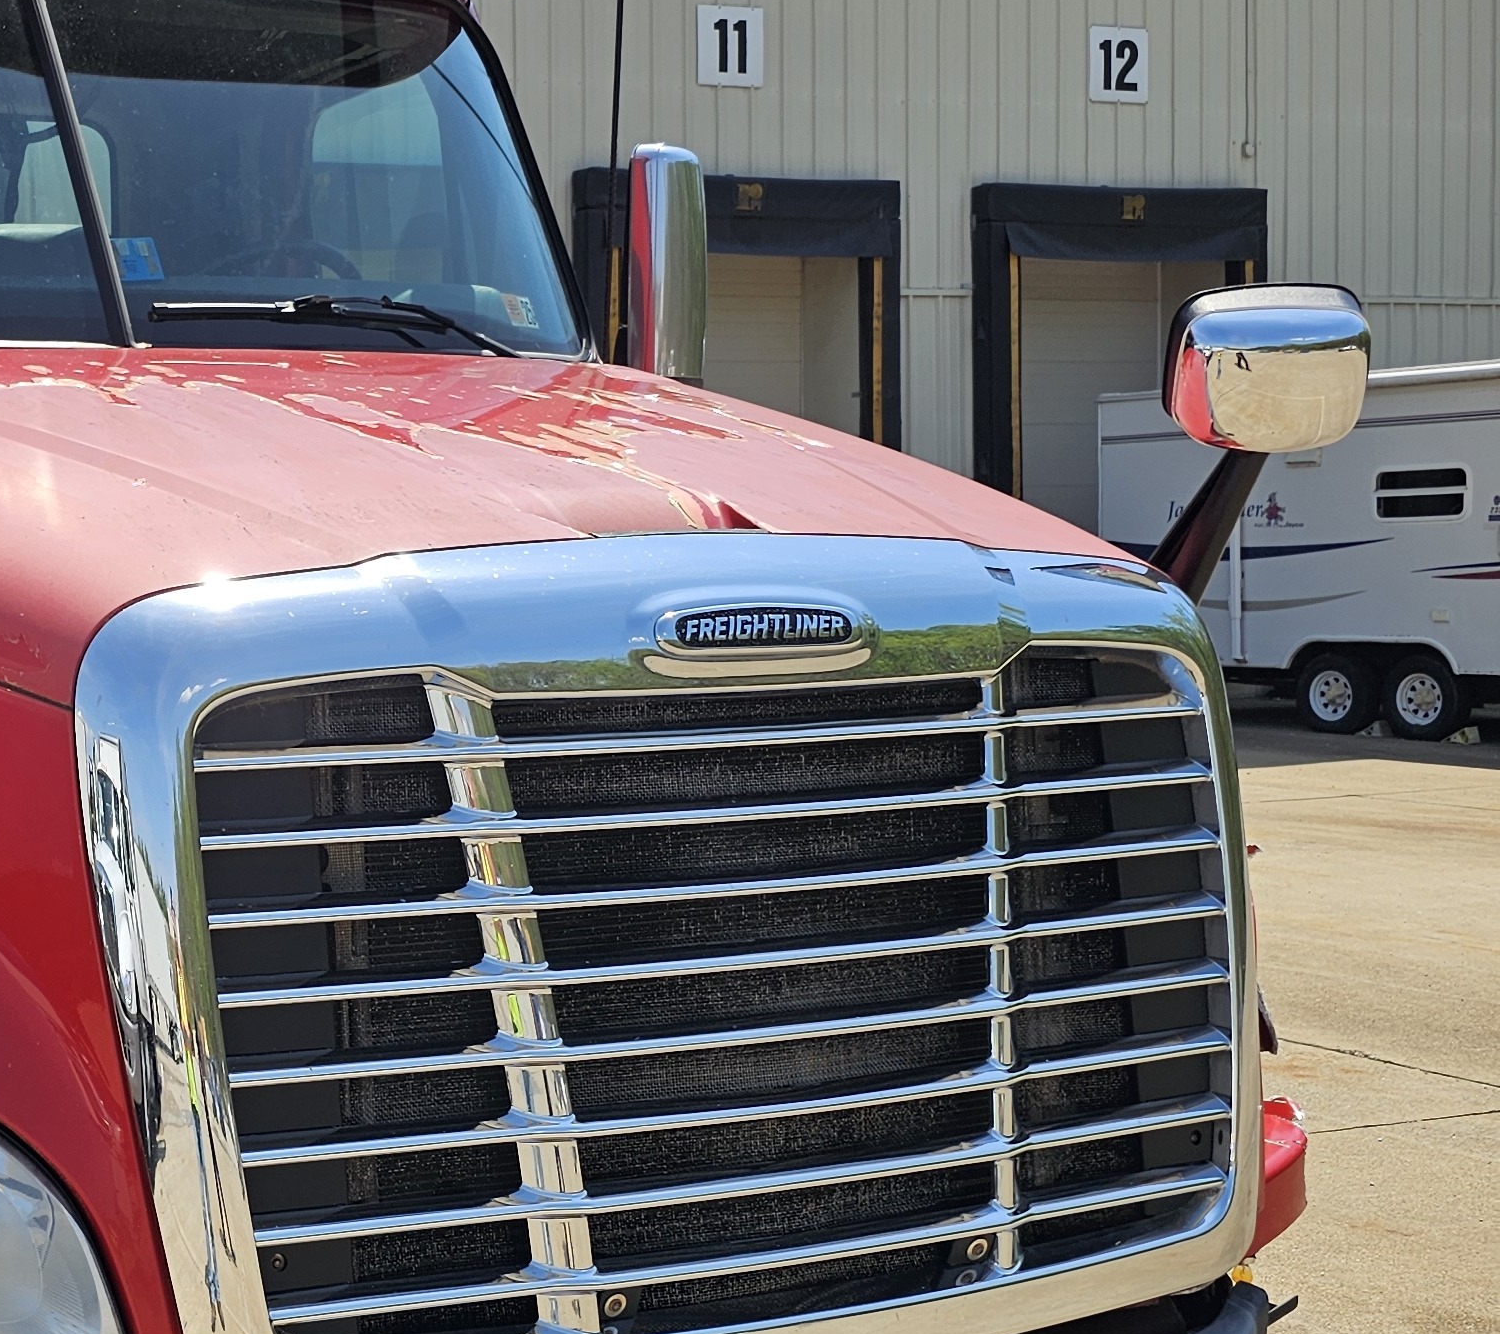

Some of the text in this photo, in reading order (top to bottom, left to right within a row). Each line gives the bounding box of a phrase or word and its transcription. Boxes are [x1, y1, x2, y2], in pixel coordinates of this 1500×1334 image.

[713, 18, 747, 74] 11
[1098, 39, 1139, 92] 12
[685, 614, 845, 642] FREIGHTLINER
